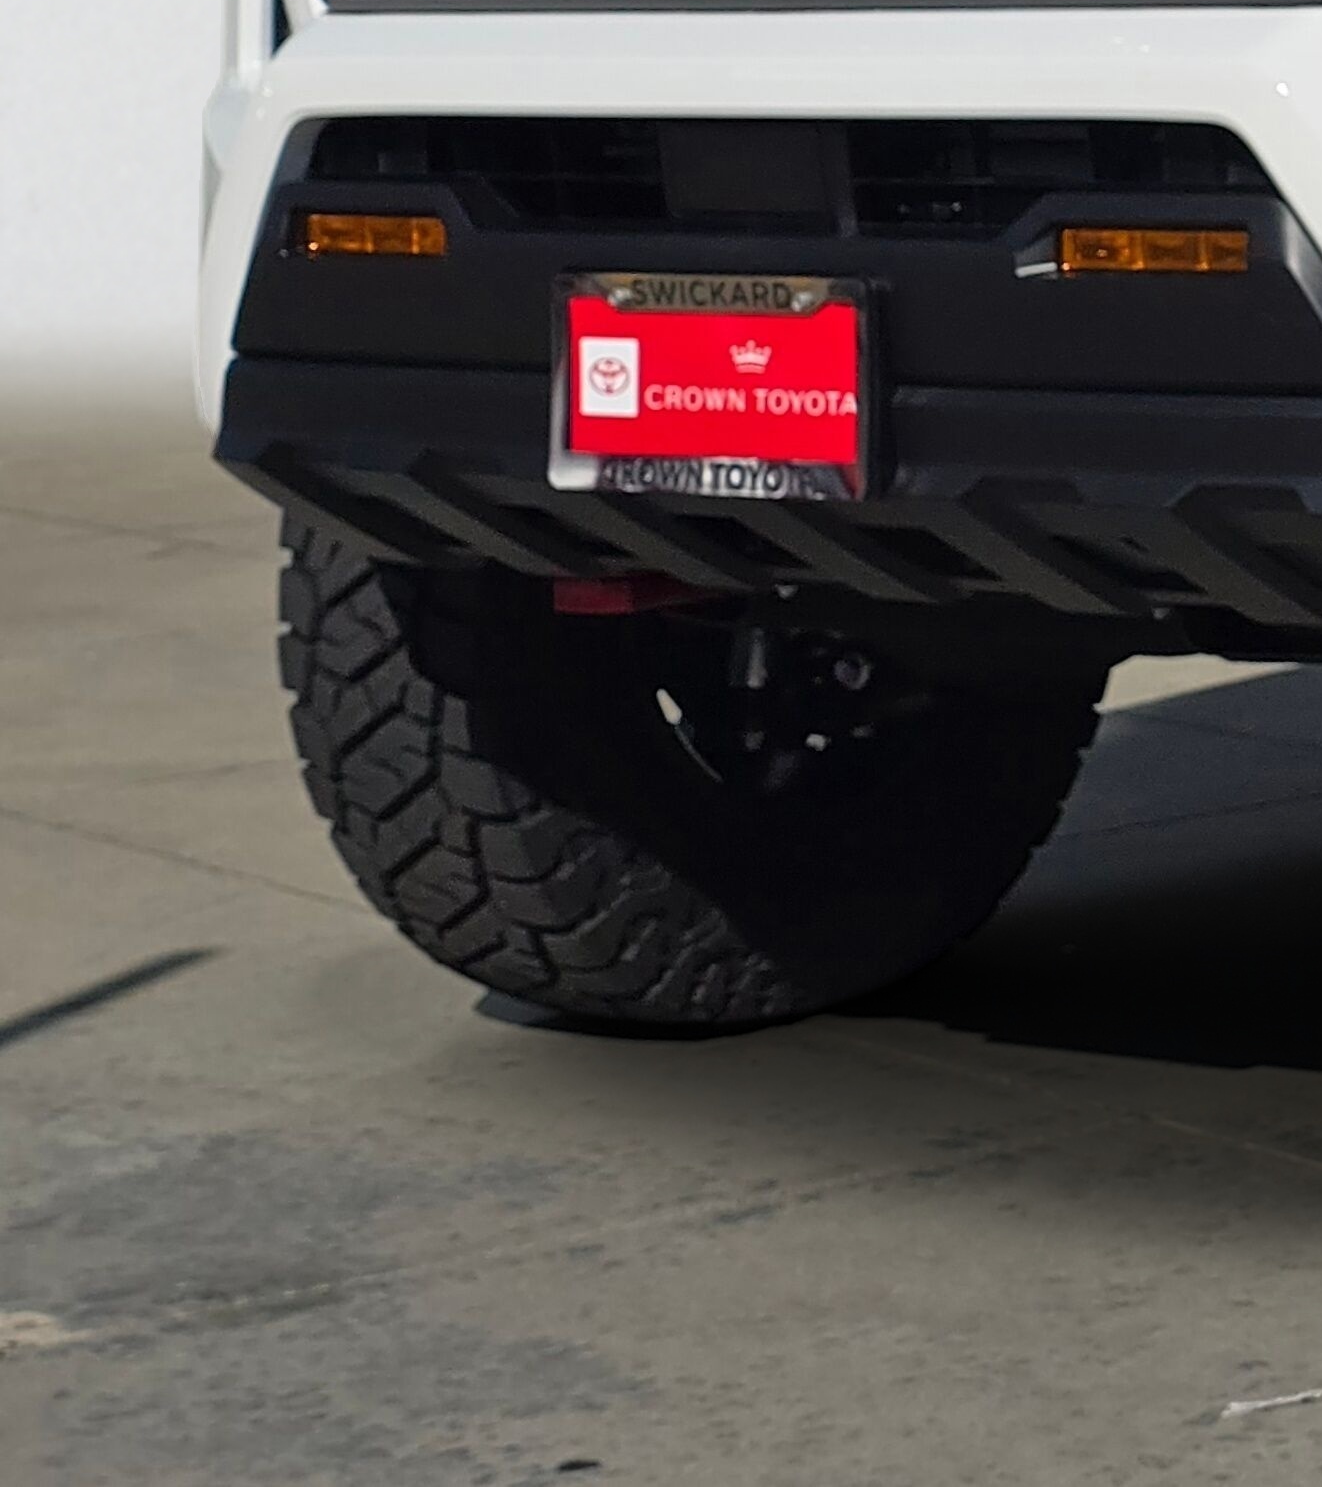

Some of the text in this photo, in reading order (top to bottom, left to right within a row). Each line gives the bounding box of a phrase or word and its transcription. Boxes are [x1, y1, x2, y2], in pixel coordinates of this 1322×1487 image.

[629, 279, 793, 309] SWICKARD
[643, 384, 858, 416] CROWN TOYOTA
